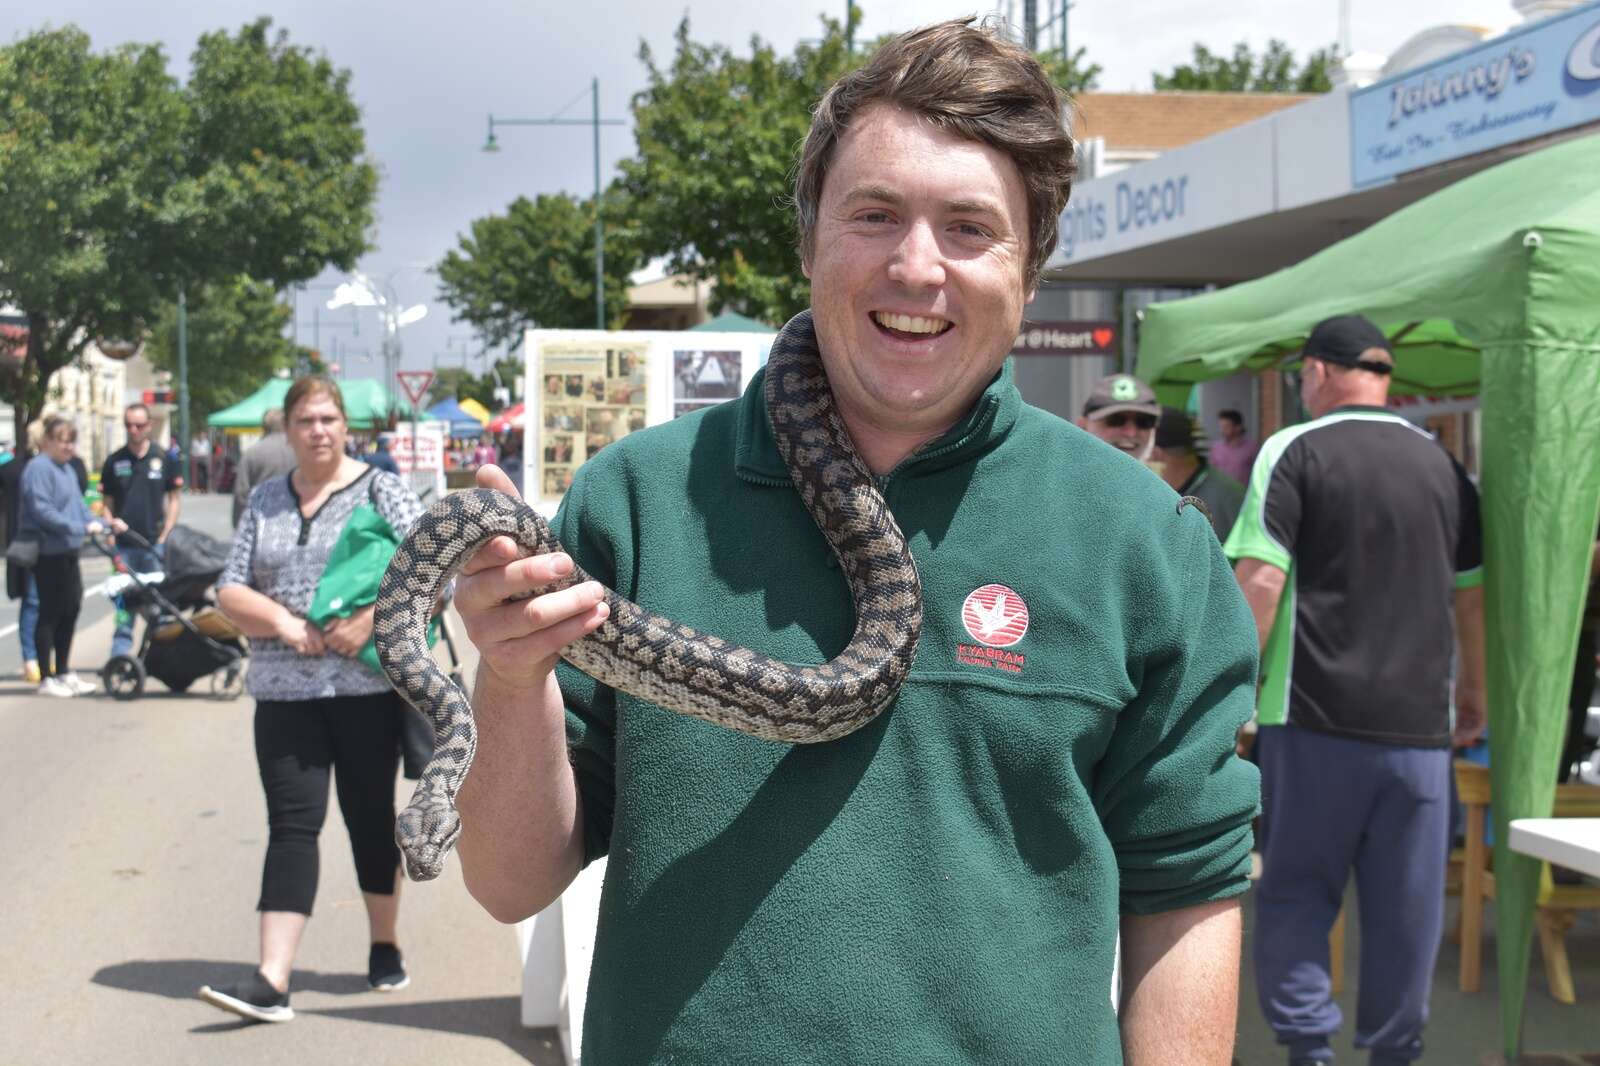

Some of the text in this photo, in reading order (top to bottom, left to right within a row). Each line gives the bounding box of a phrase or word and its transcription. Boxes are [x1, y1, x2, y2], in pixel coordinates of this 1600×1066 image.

[1387, 48, 1536, 129] Johnny's
[1116, 173, 1188, 233] Decor
[958, 644, 1025, 665] KYABRAM
